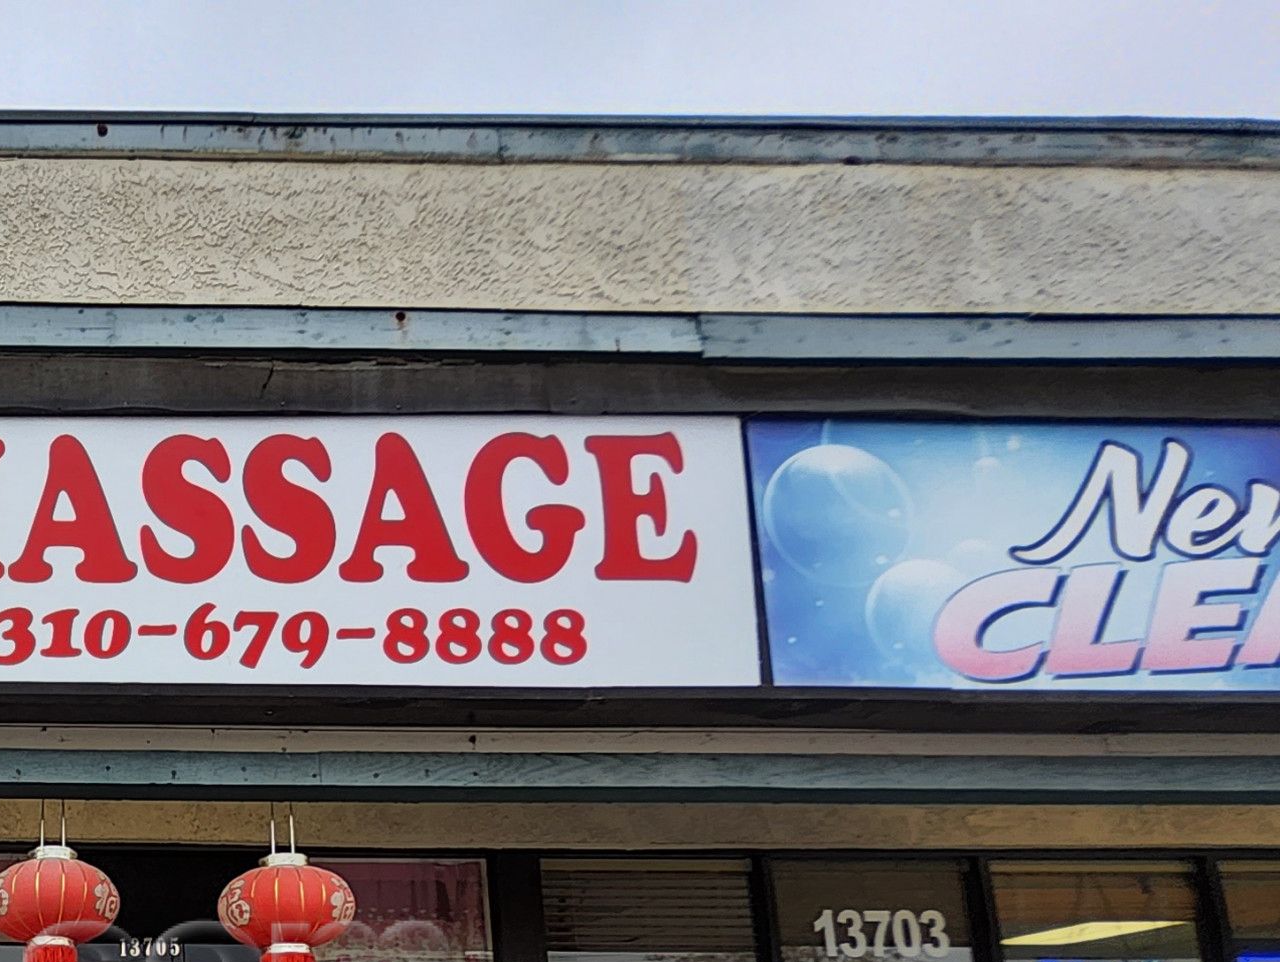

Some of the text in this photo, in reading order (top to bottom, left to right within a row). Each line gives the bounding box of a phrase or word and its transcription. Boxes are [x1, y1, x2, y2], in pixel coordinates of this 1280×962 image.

[932, 556, 1280, 684] CLE
[120, 937, 180, 957] 13705
[813, 909, 950, 958] 13703
